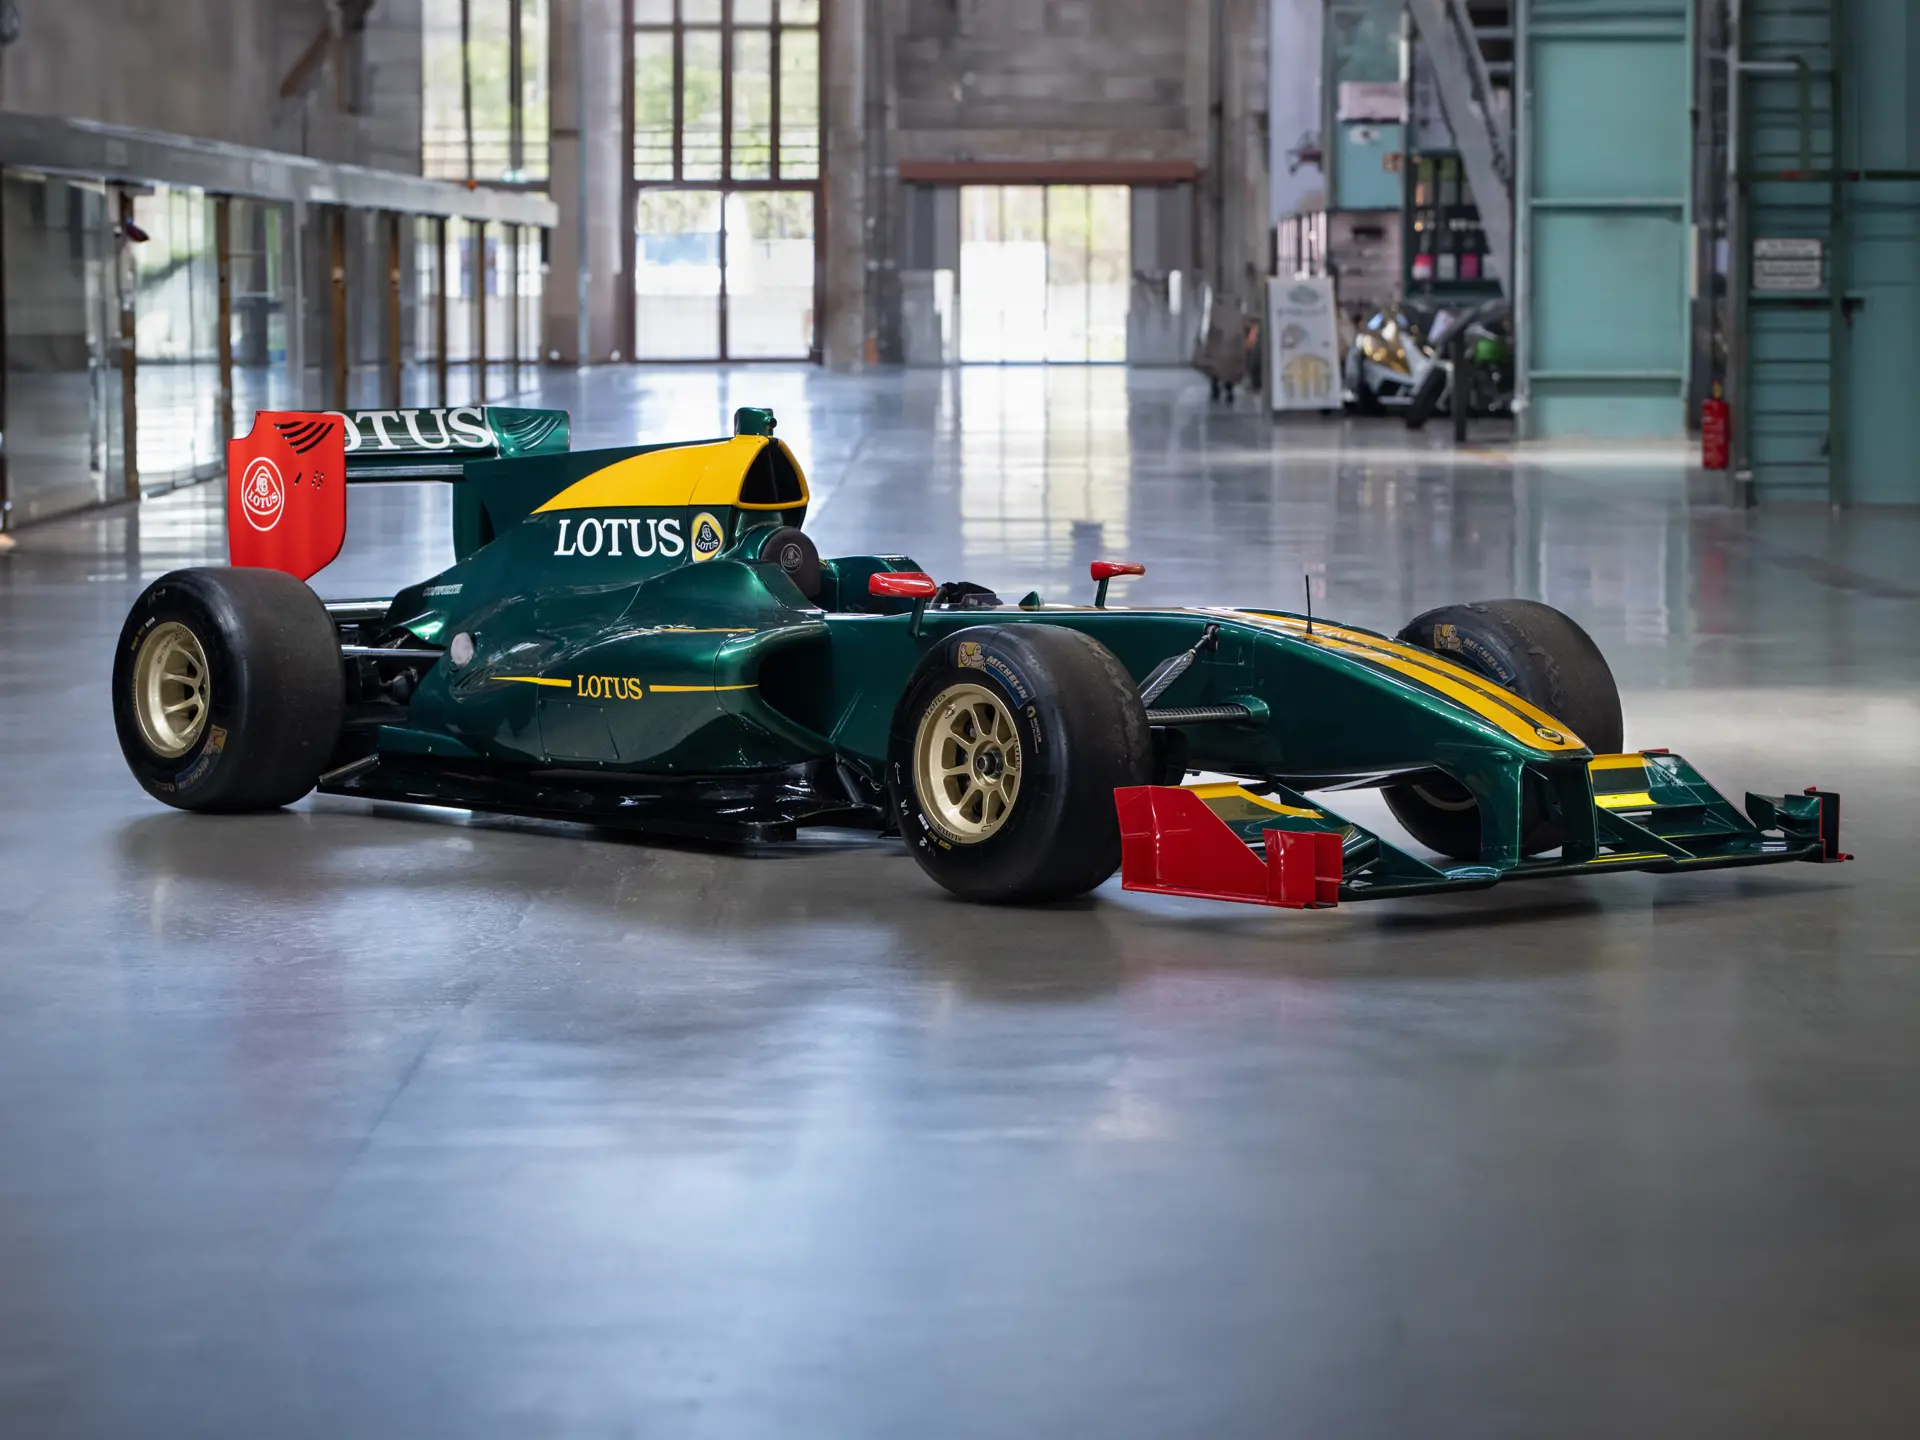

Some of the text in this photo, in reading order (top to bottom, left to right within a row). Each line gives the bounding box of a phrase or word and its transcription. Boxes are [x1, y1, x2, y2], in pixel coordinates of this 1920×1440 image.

[321, 406, 493, 452] OTUS
[248, 489, 278, 509] LOTUS
[554, 518, 684, 557] LOTUS
[696, 539, 719, 551] LOTUS
[1463, 637, 1508, 681] MICHELIN
[577, 674, 643, 700] LOTUS
[986, 655, 1028, 699] MICHELIN
[926, 692, 946, 716] LOTUS
[1014, 739, 1022, 772] LOTUS
[937, 823, 962, 841] LOTUS
